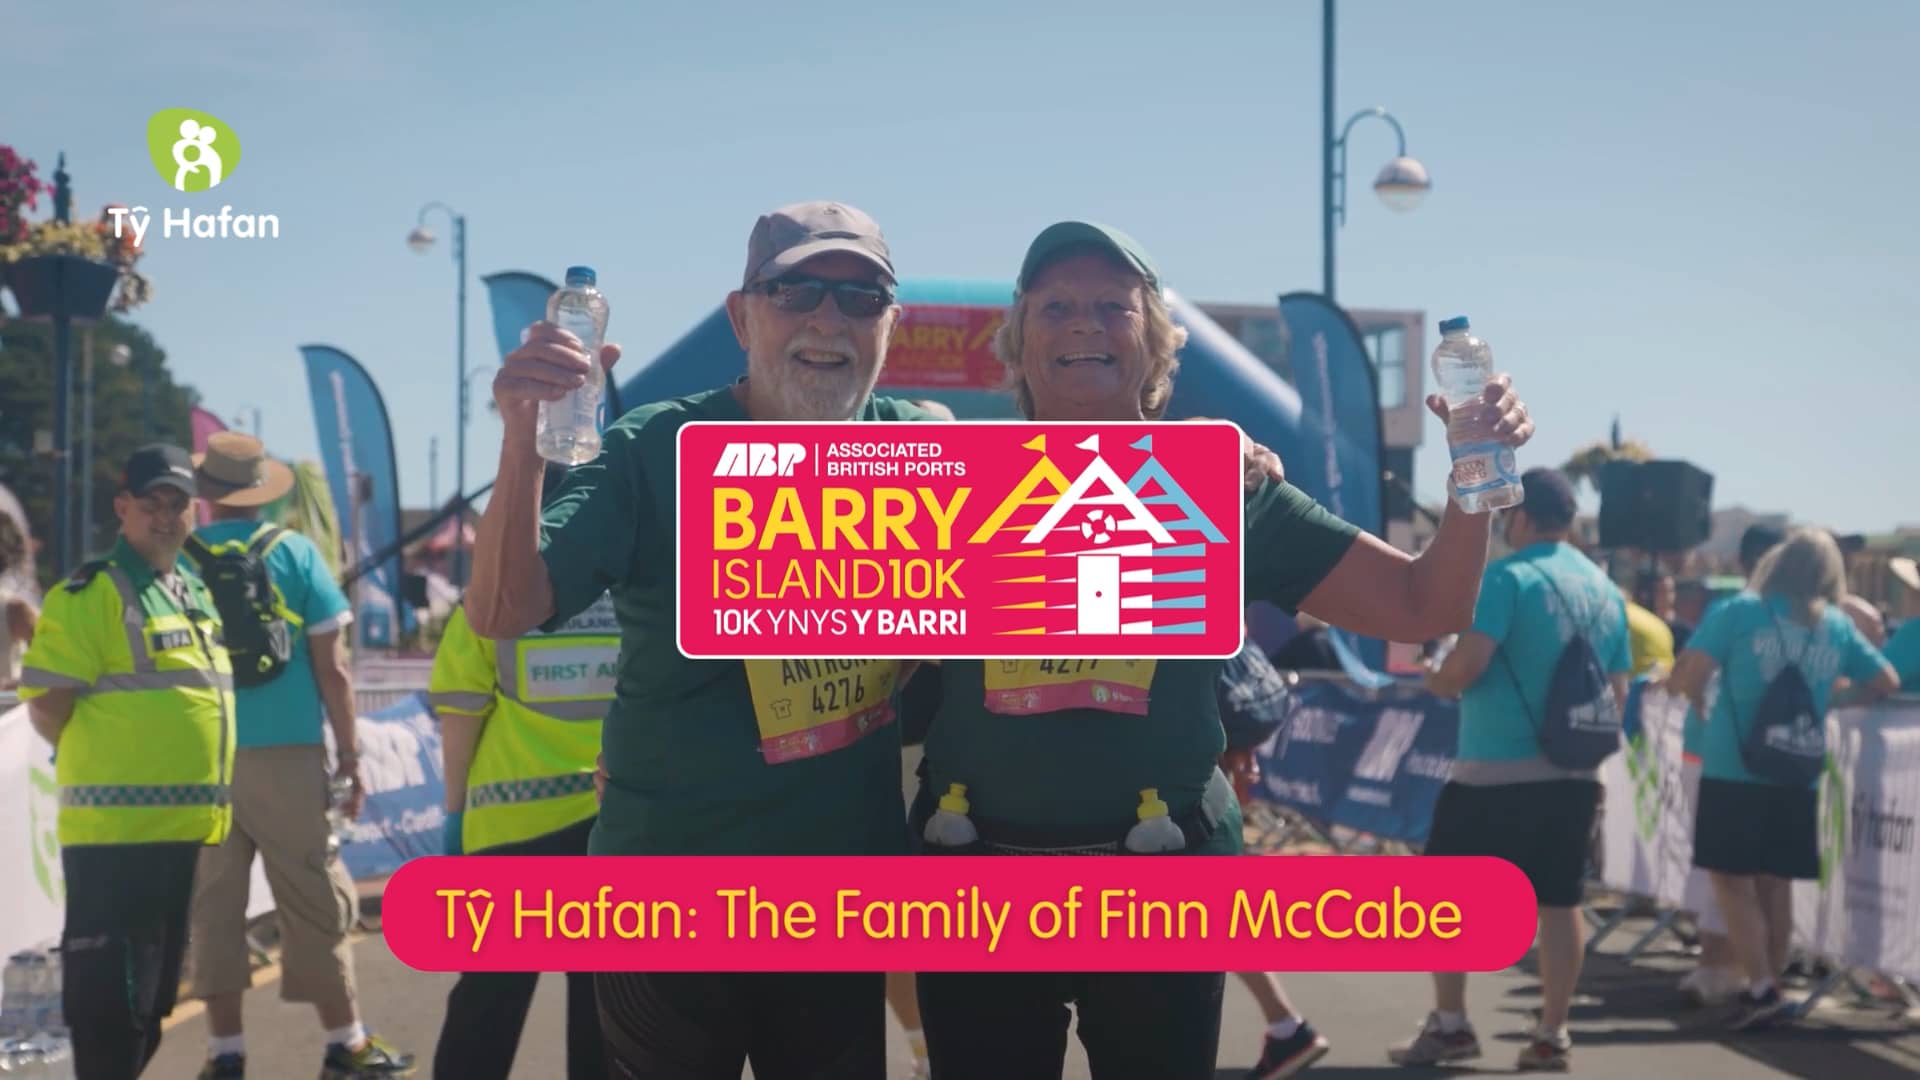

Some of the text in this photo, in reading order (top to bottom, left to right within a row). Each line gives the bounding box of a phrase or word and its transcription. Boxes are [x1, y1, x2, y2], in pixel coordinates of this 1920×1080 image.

[888, 324, 968, 350] ARRY
[531, 662, 618, 681] FIRST AI
[812, 674, 865, 714] 4276
